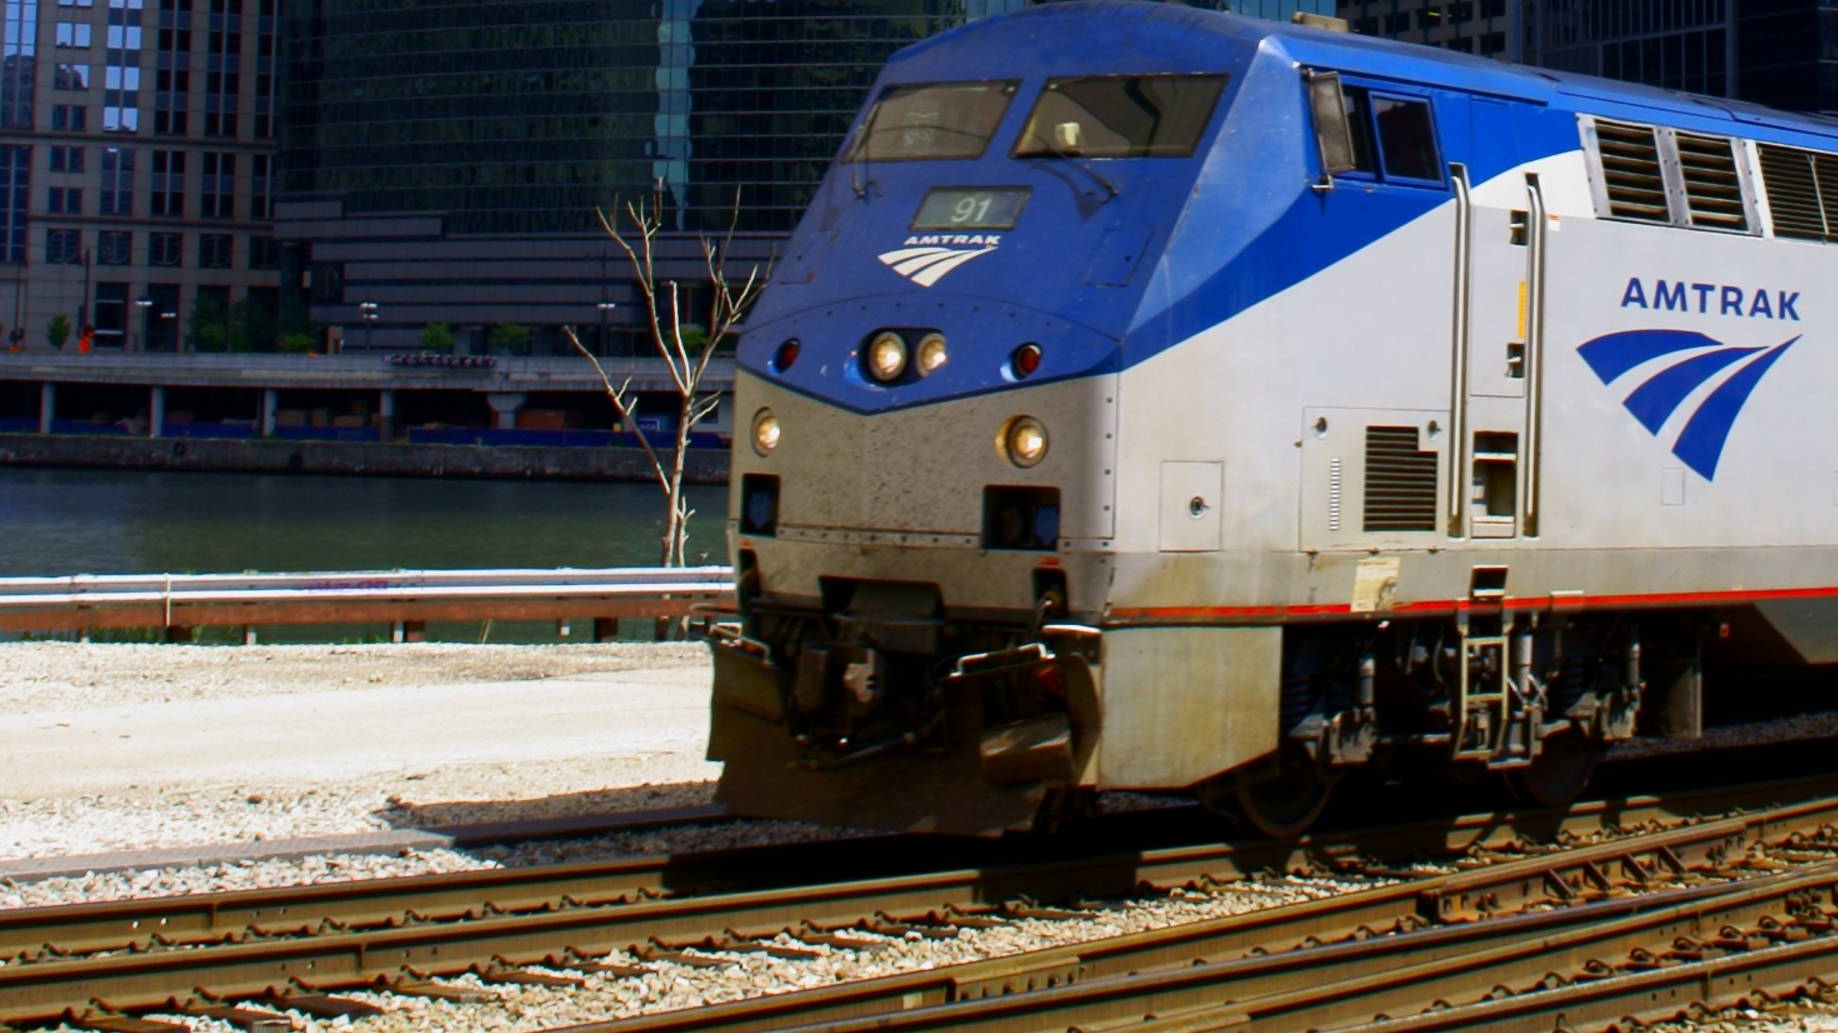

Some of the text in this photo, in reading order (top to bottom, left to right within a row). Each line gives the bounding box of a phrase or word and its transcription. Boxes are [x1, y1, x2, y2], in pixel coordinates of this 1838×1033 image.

[952, 196, 993, 223] 91
[903, 234, 1002, 246] AMTRAK
[1620, 276, 1801, 321] AMTRAK
